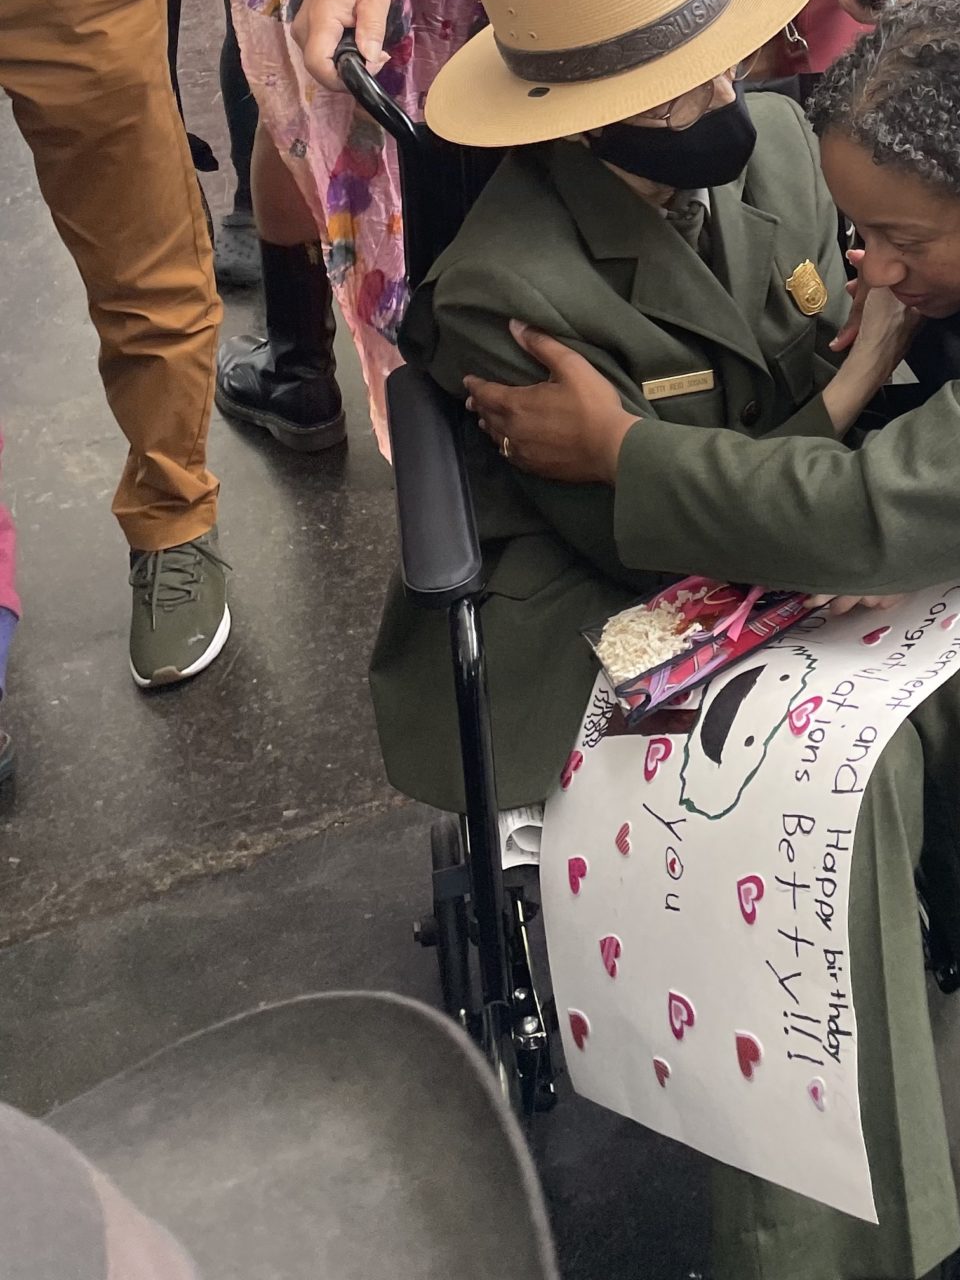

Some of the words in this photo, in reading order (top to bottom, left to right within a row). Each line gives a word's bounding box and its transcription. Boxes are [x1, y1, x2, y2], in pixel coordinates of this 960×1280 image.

[831, 725, 879, 795] and
[642, 802, 687, 912] you
[814, 828, 852, 932] Happy
[766, 813, 825, 1066] Betty!!!
[822, 948, 853, 1065] birthday
